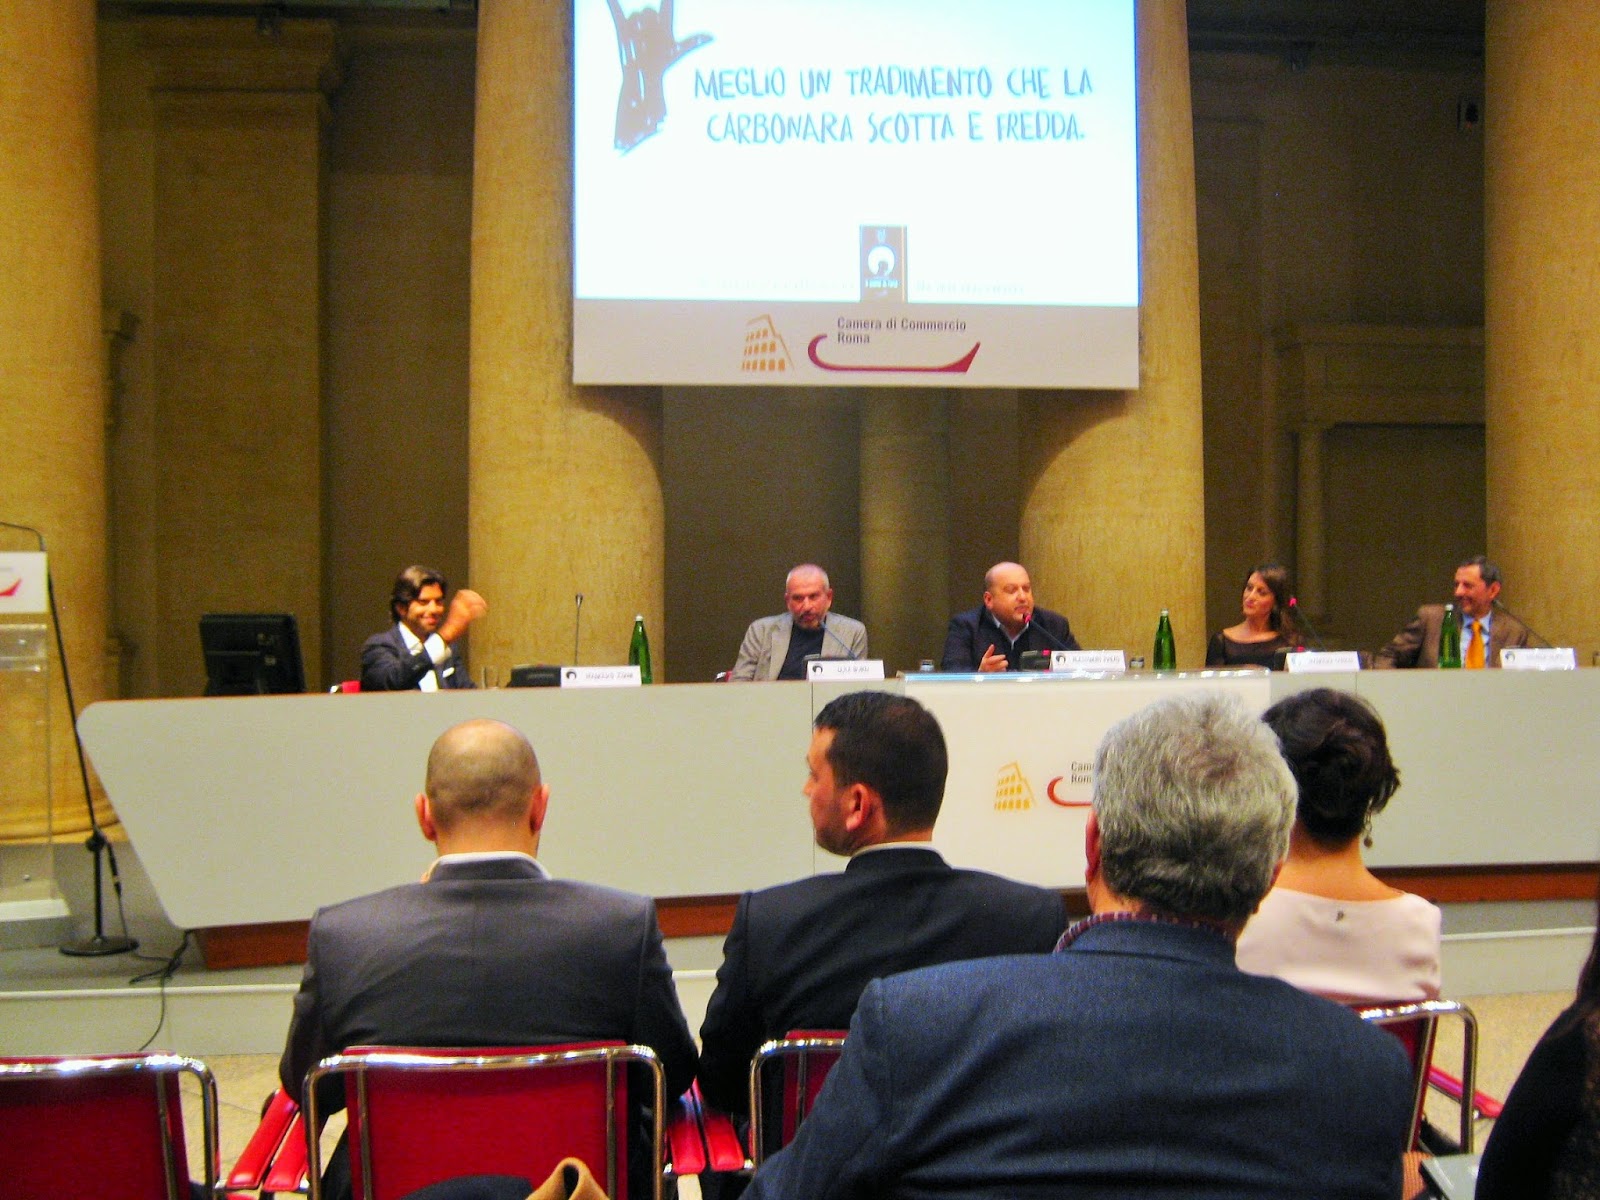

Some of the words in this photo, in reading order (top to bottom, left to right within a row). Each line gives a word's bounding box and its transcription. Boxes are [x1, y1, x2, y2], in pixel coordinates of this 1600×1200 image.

[694, 66, 786, 101] MEGLIO
[799, 67, 832, 100] UN
[844, 64, 993, 99] TRADIMENTO
[1006, 66, 1050, 99] CHE
[1063, 67, 1093, 97] LA
[706, 111, 853, 145] CARBONARA
[867, 110, 955, 144] SCOTTA
[968, 110, 985, 141] E
[996, 109, 1085, 142] FREDDA.
[837, 316, 882, 330] Camera
[885, 317, 897, 330] di
[901, 317, 966, 331] Commercio
[837, 331, 870, 344] Roma
[1071, 774, 1093, 784] Rom
